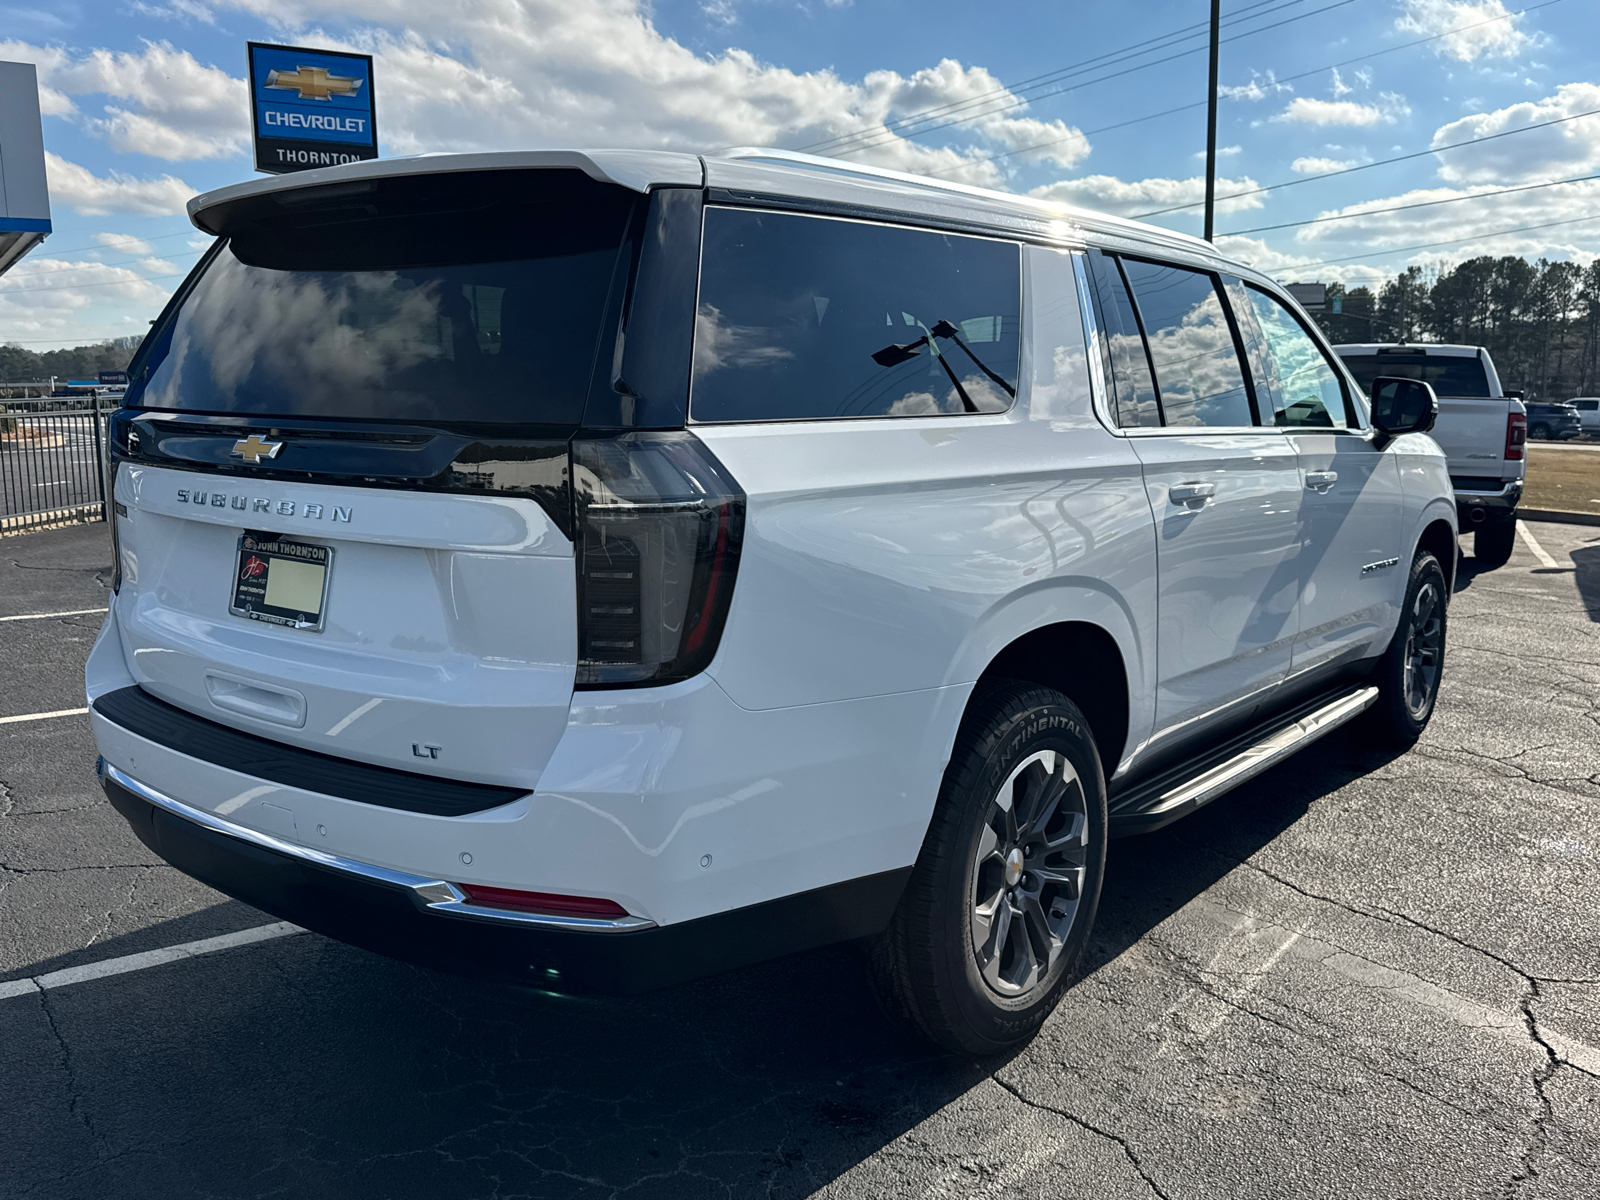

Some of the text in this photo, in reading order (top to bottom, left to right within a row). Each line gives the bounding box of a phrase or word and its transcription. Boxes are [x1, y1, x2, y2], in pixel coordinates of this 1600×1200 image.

[265, 111, 366, 132] CHEVROLET
[276, 149, 360, 165] THORNTON
[177, 489, 352, 523] SUBURBAN
[257, 541, 279, 553] JOHN
[280, 543, 325, 560] THORNTON
[259, 614, 286, 625] CHEVROLET
[412, 743, 442, 760] LT
[979, 716, 1083, 809] CONTINENTAL
